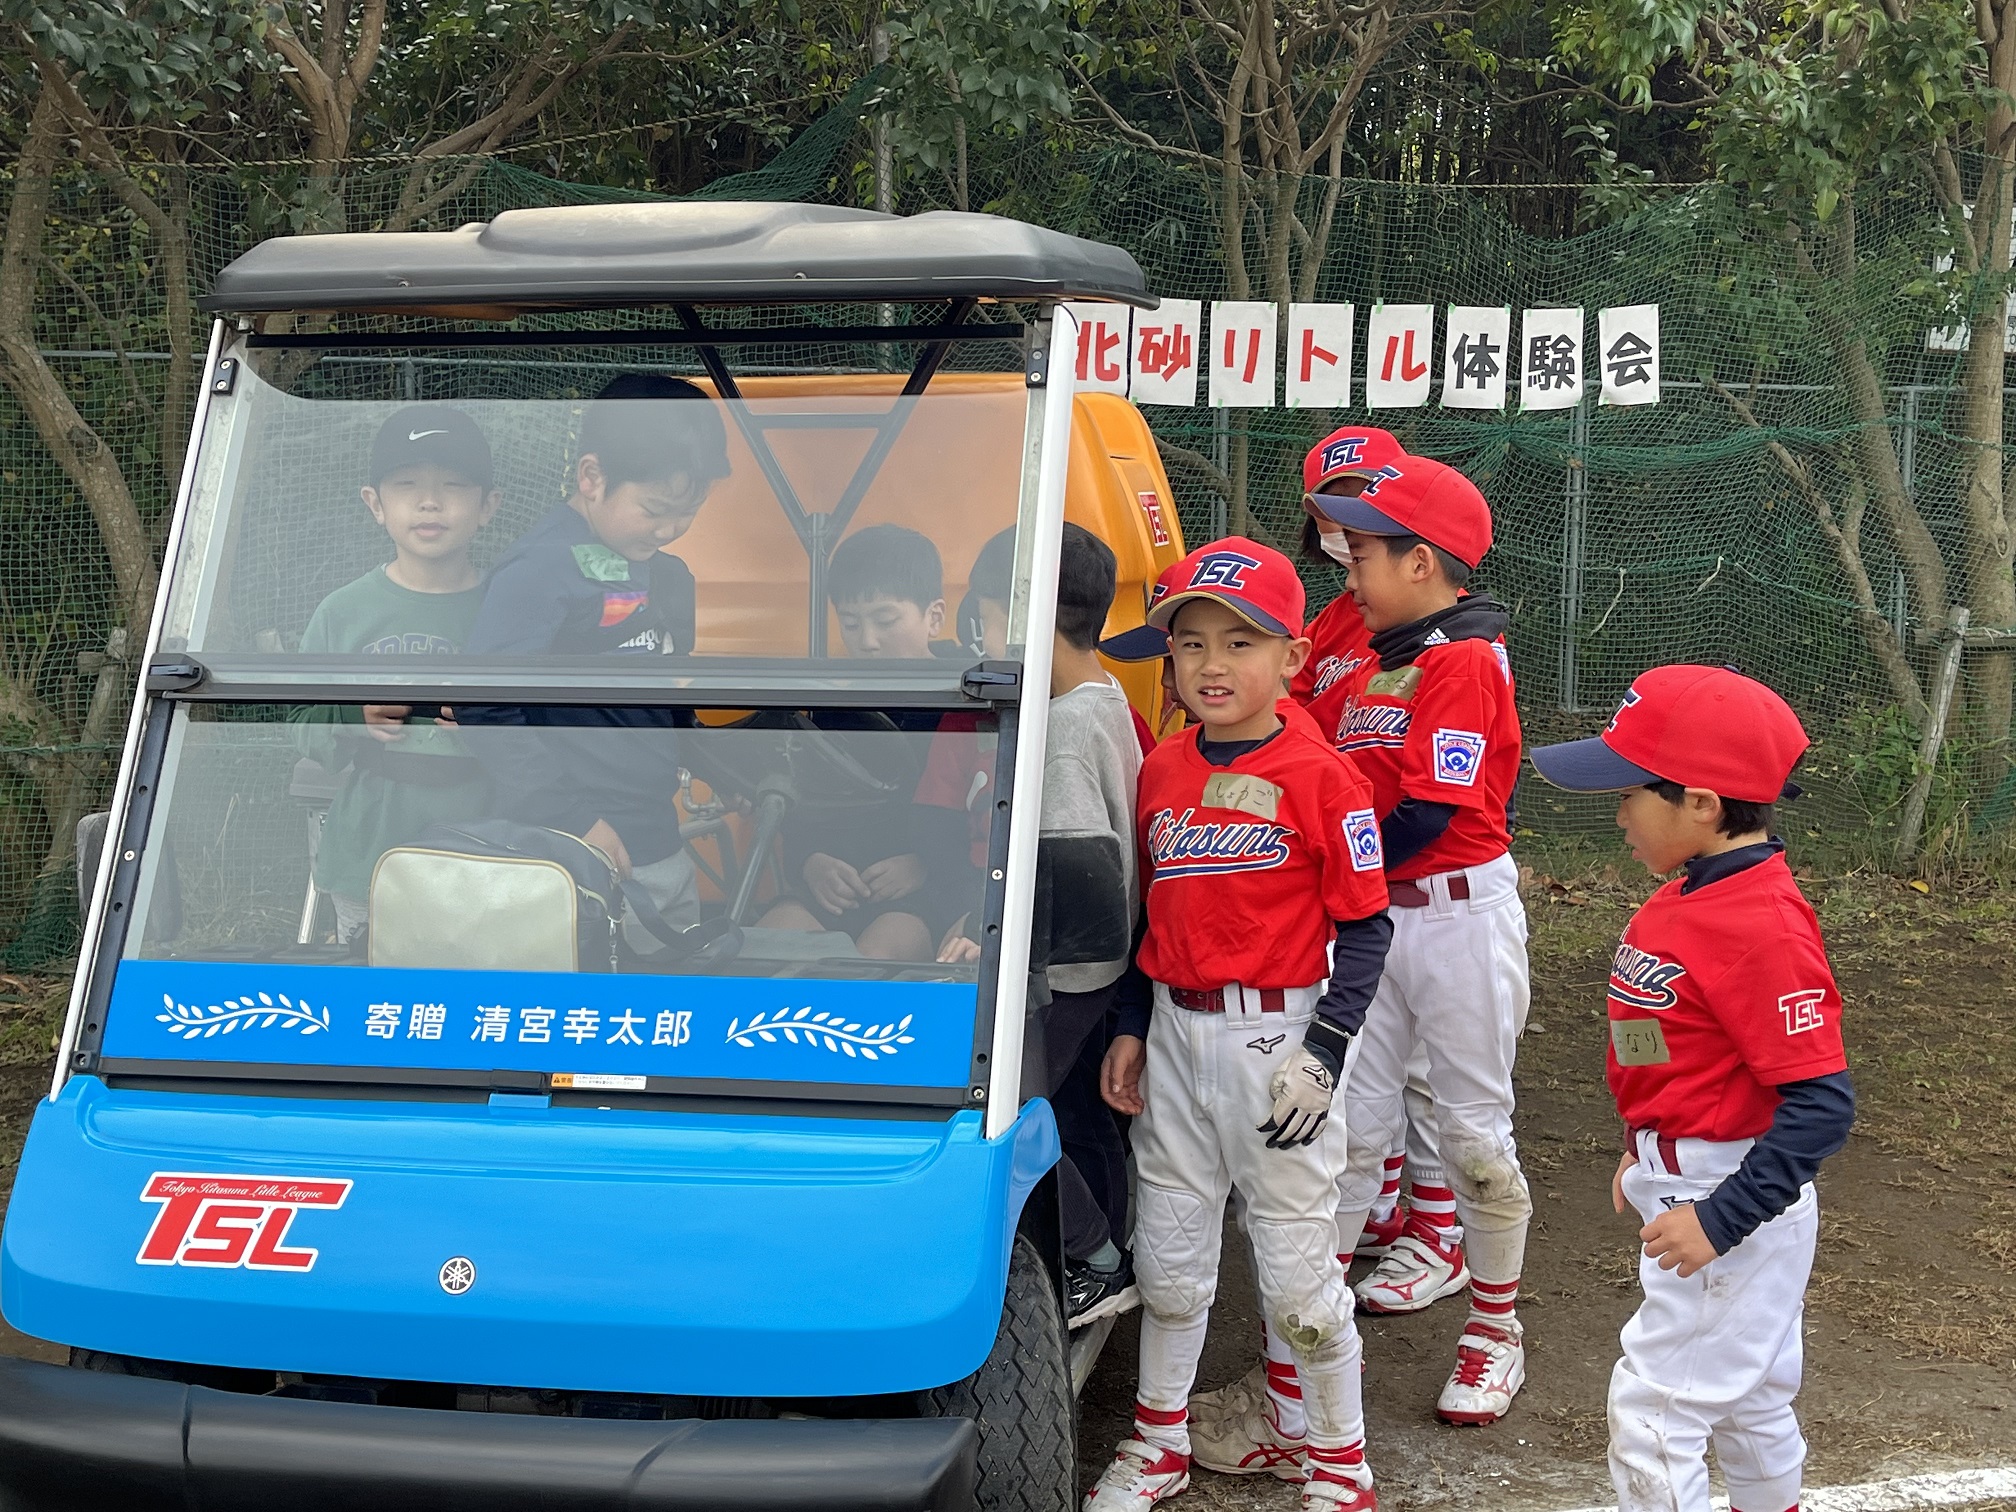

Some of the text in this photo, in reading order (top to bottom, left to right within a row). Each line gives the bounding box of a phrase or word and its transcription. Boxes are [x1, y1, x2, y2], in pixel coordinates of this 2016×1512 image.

[1075, 320, 1653, 391] 北砂リトル体験会
[1321, 437, 1369, 476] TSL
[1187, 551, 1262, 590] TSL
[364, 1002, 693, 1048] 寄贈 清宮幸太郎
[159, 1180, 196, 1197] Tokyo
[197, 1182, 249, 1196] Kitasuna
[280, 1185, 323, 1202] League
[138, 1173, 352, 1271] TSL
